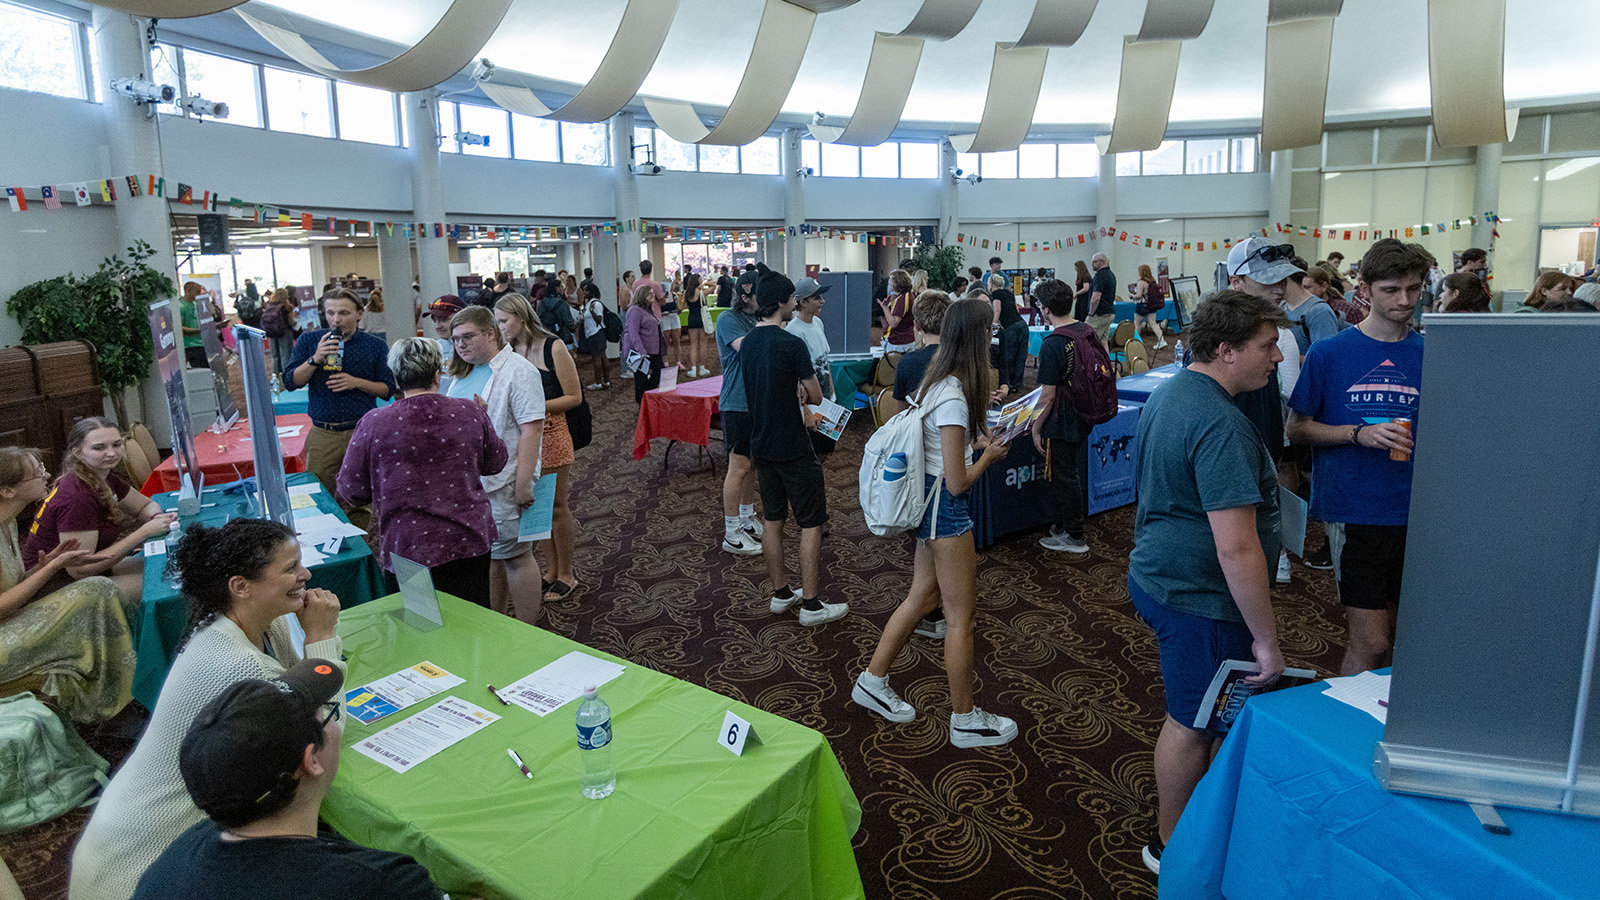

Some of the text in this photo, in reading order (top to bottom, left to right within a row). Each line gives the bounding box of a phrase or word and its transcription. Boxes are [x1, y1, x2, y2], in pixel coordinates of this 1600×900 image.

[1351, 393, 1415, 405] HURLEY
[1005, 457, 1036, 489] api
[328, 537, 338, 550] 7
[728, 723, 739, 746] 6
